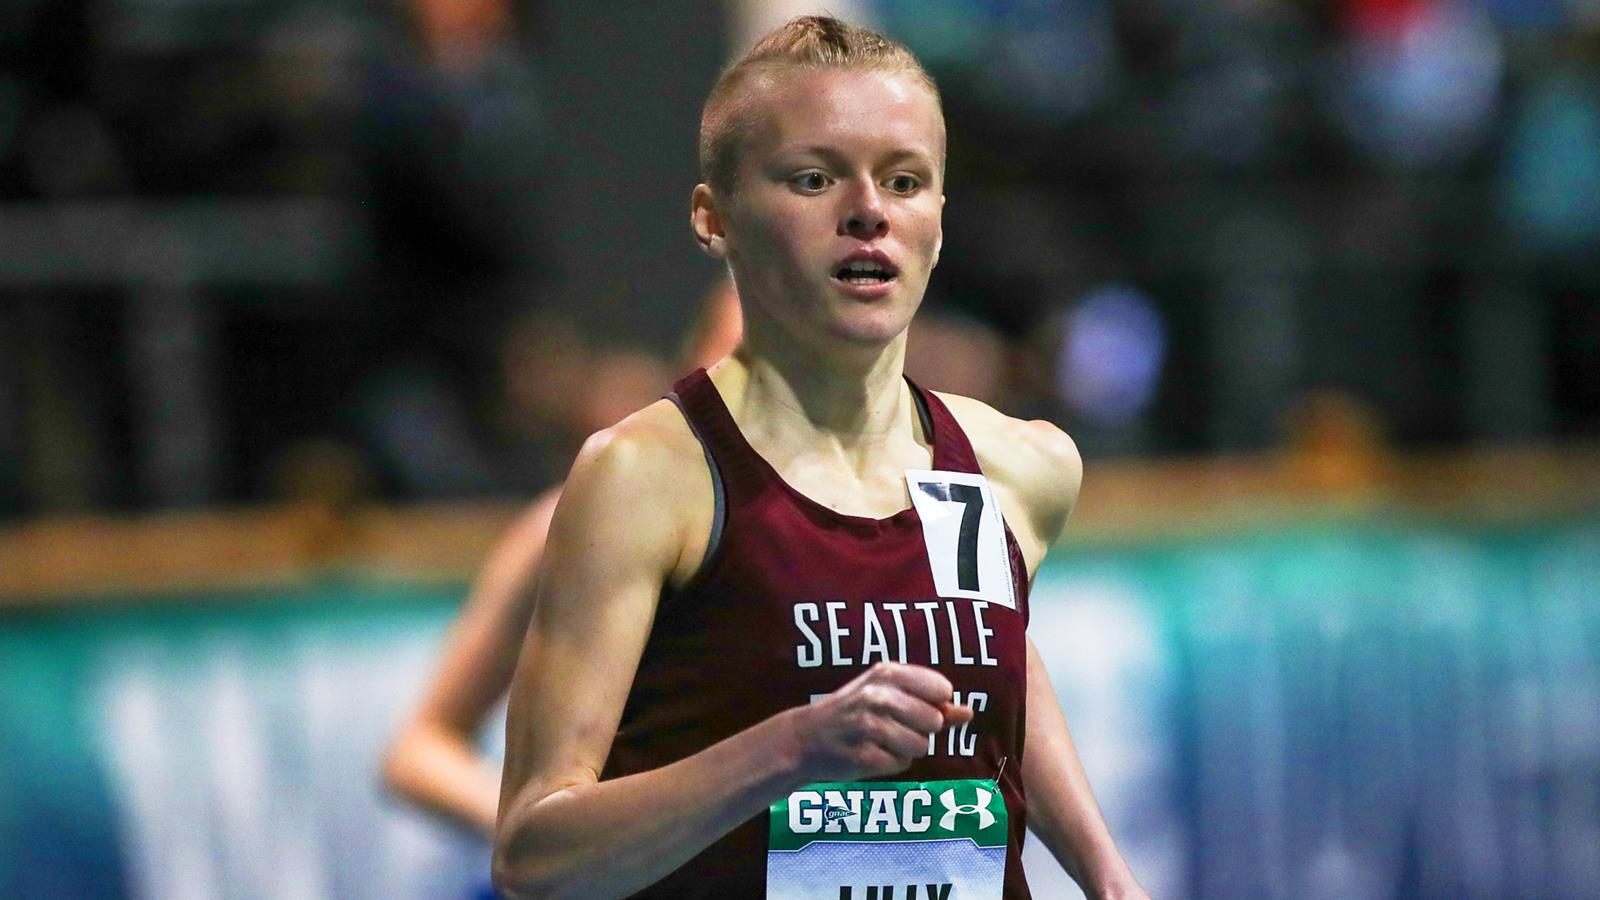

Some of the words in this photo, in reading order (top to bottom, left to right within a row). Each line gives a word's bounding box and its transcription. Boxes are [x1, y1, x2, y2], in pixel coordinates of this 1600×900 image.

[917, 481, 985, 593] 7
[793, 601, 998, 668] SEATTLE
[788, 789, 932, 834] GNAC
